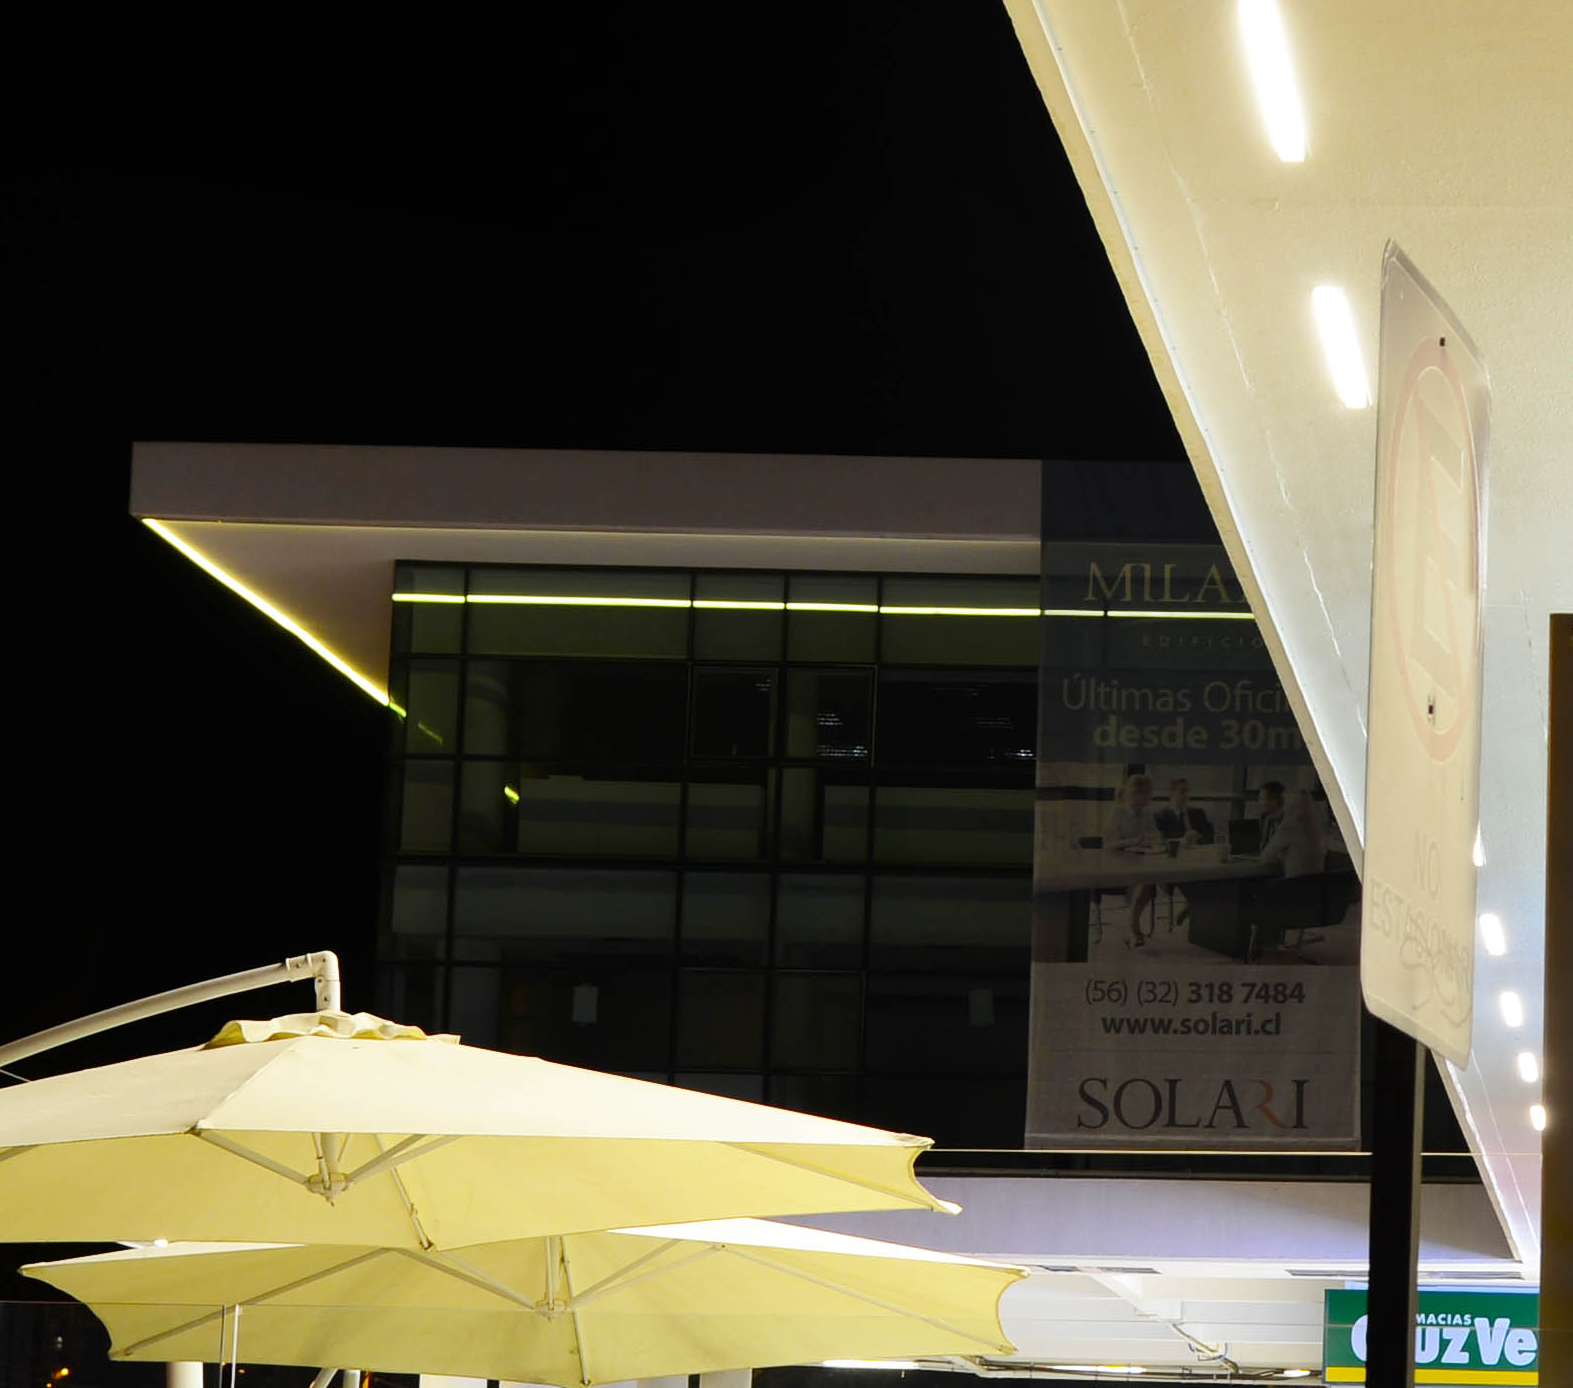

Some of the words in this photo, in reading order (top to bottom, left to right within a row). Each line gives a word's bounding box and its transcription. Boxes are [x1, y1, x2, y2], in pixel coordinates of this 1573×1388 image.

[1084, 562, 1248, 603] MILA
[1062, 672, 1191, 711] Últimas
[1093, 715, 1208, 748] desde
[1085, 979, 1128, 1006] (56)
[1137, 979, 1178, 1007] (32)
[1187, 982, 1233, 1005] 318
[1241, 982, 1306, 1005] 7484
[1101, 1012, 1282, 1036] www.solari.cl
[1077, 1076, 1310, 1130] SOLARI
